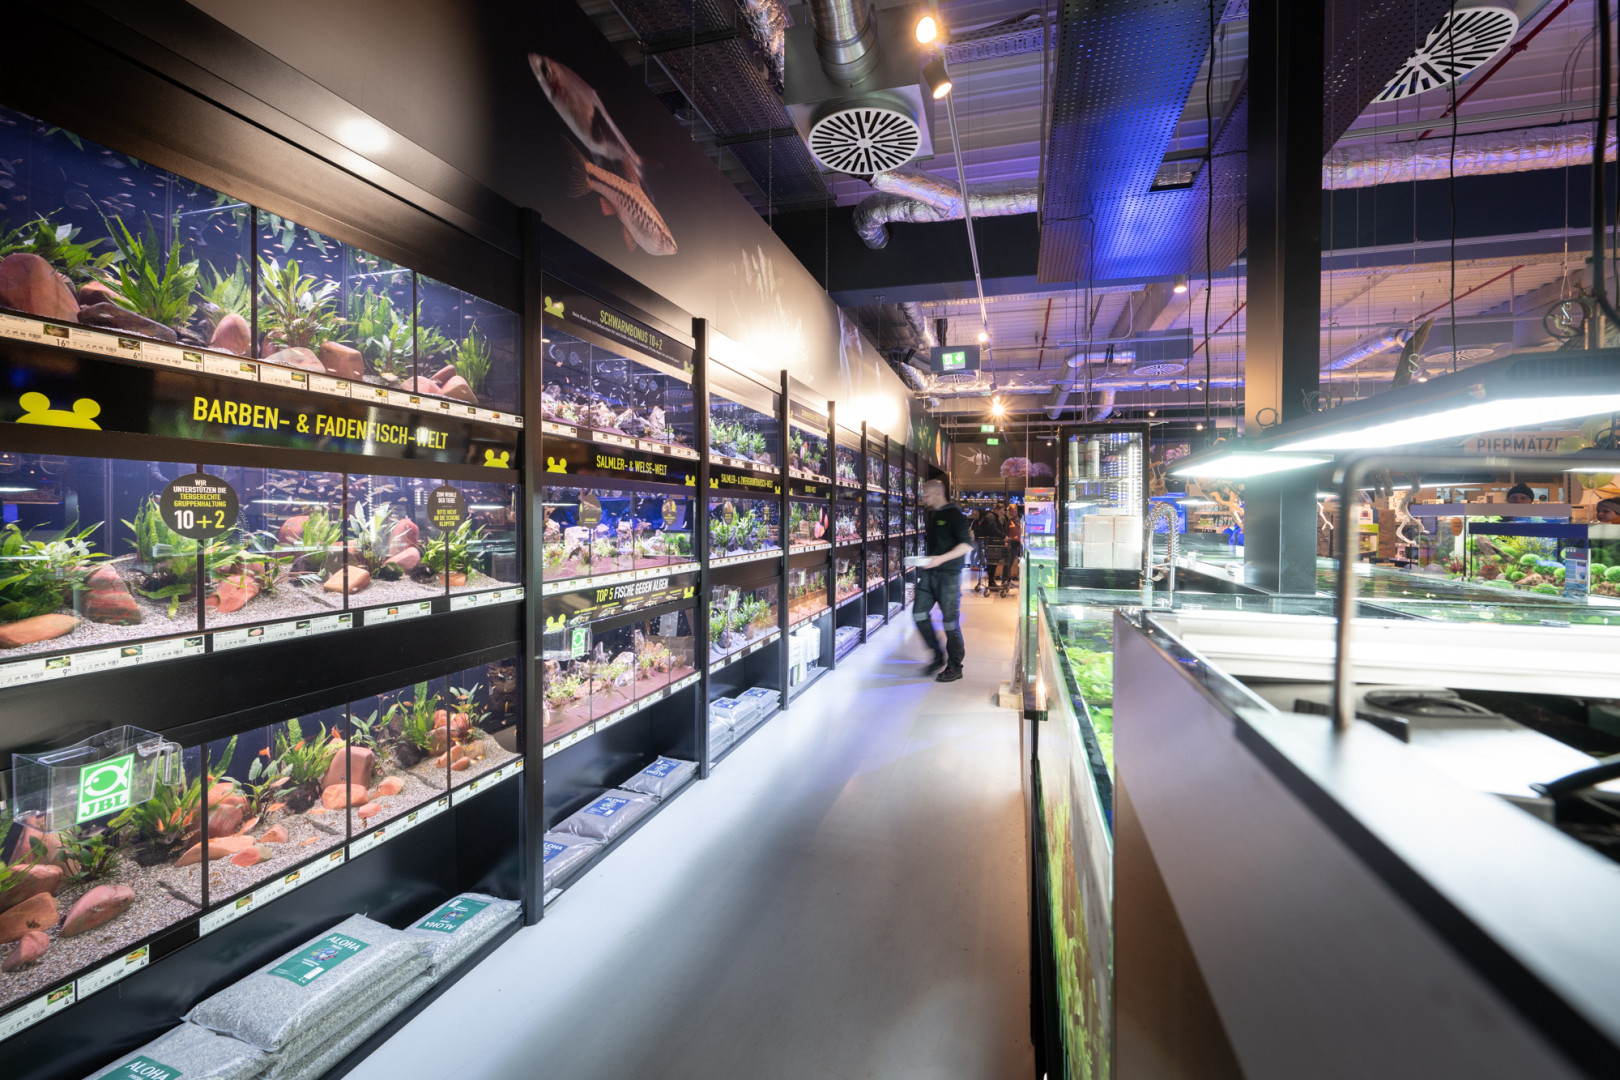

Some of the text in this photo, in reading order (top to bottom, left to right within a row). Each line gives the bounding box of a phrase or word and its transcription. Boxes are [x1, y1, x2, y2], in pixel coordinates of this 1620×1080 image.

[600, 310, 648, 343] SCHWARMBONUS
[649, 334, 662, 350] 10+2
[193, 396, 448, 449] BARBEN- & FADENFISCH-WELT
[596, 455, 667, 476] SALMLER- & WELSE-WELT
[596, 578, 669, 603] TOP 5 FISCHE GEGEN ALGEN
[81, 794, 127, 817] JBL
[327, 936, 361, 951] ALOHA
[124, 1061, 170, 1080] ALOHA
